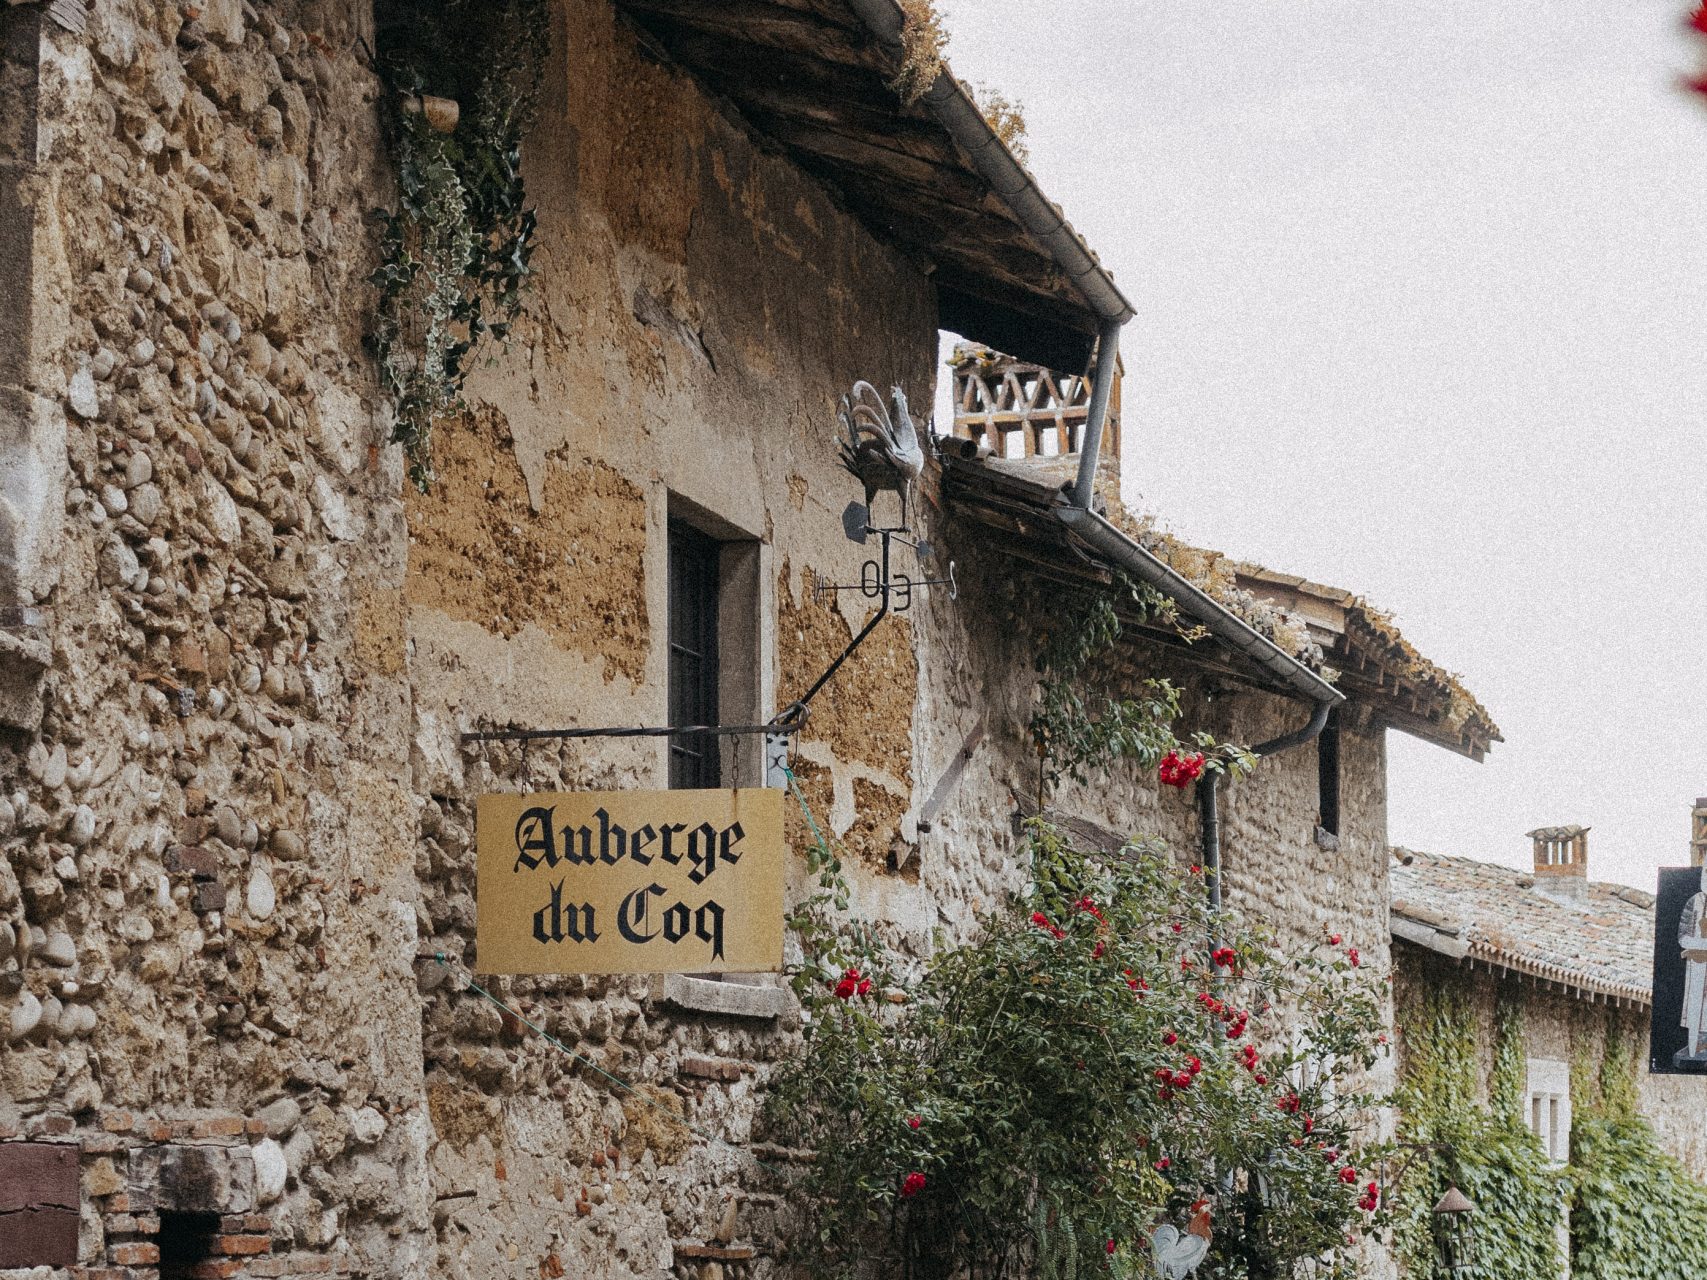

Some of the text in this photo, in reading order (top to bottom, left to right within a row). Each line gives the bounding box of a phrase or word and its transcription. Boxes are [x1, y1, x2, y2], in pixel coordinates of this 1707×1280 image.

[513, 805, 746, 885] Auberge
[532, 876, 725, 962] du Coq
